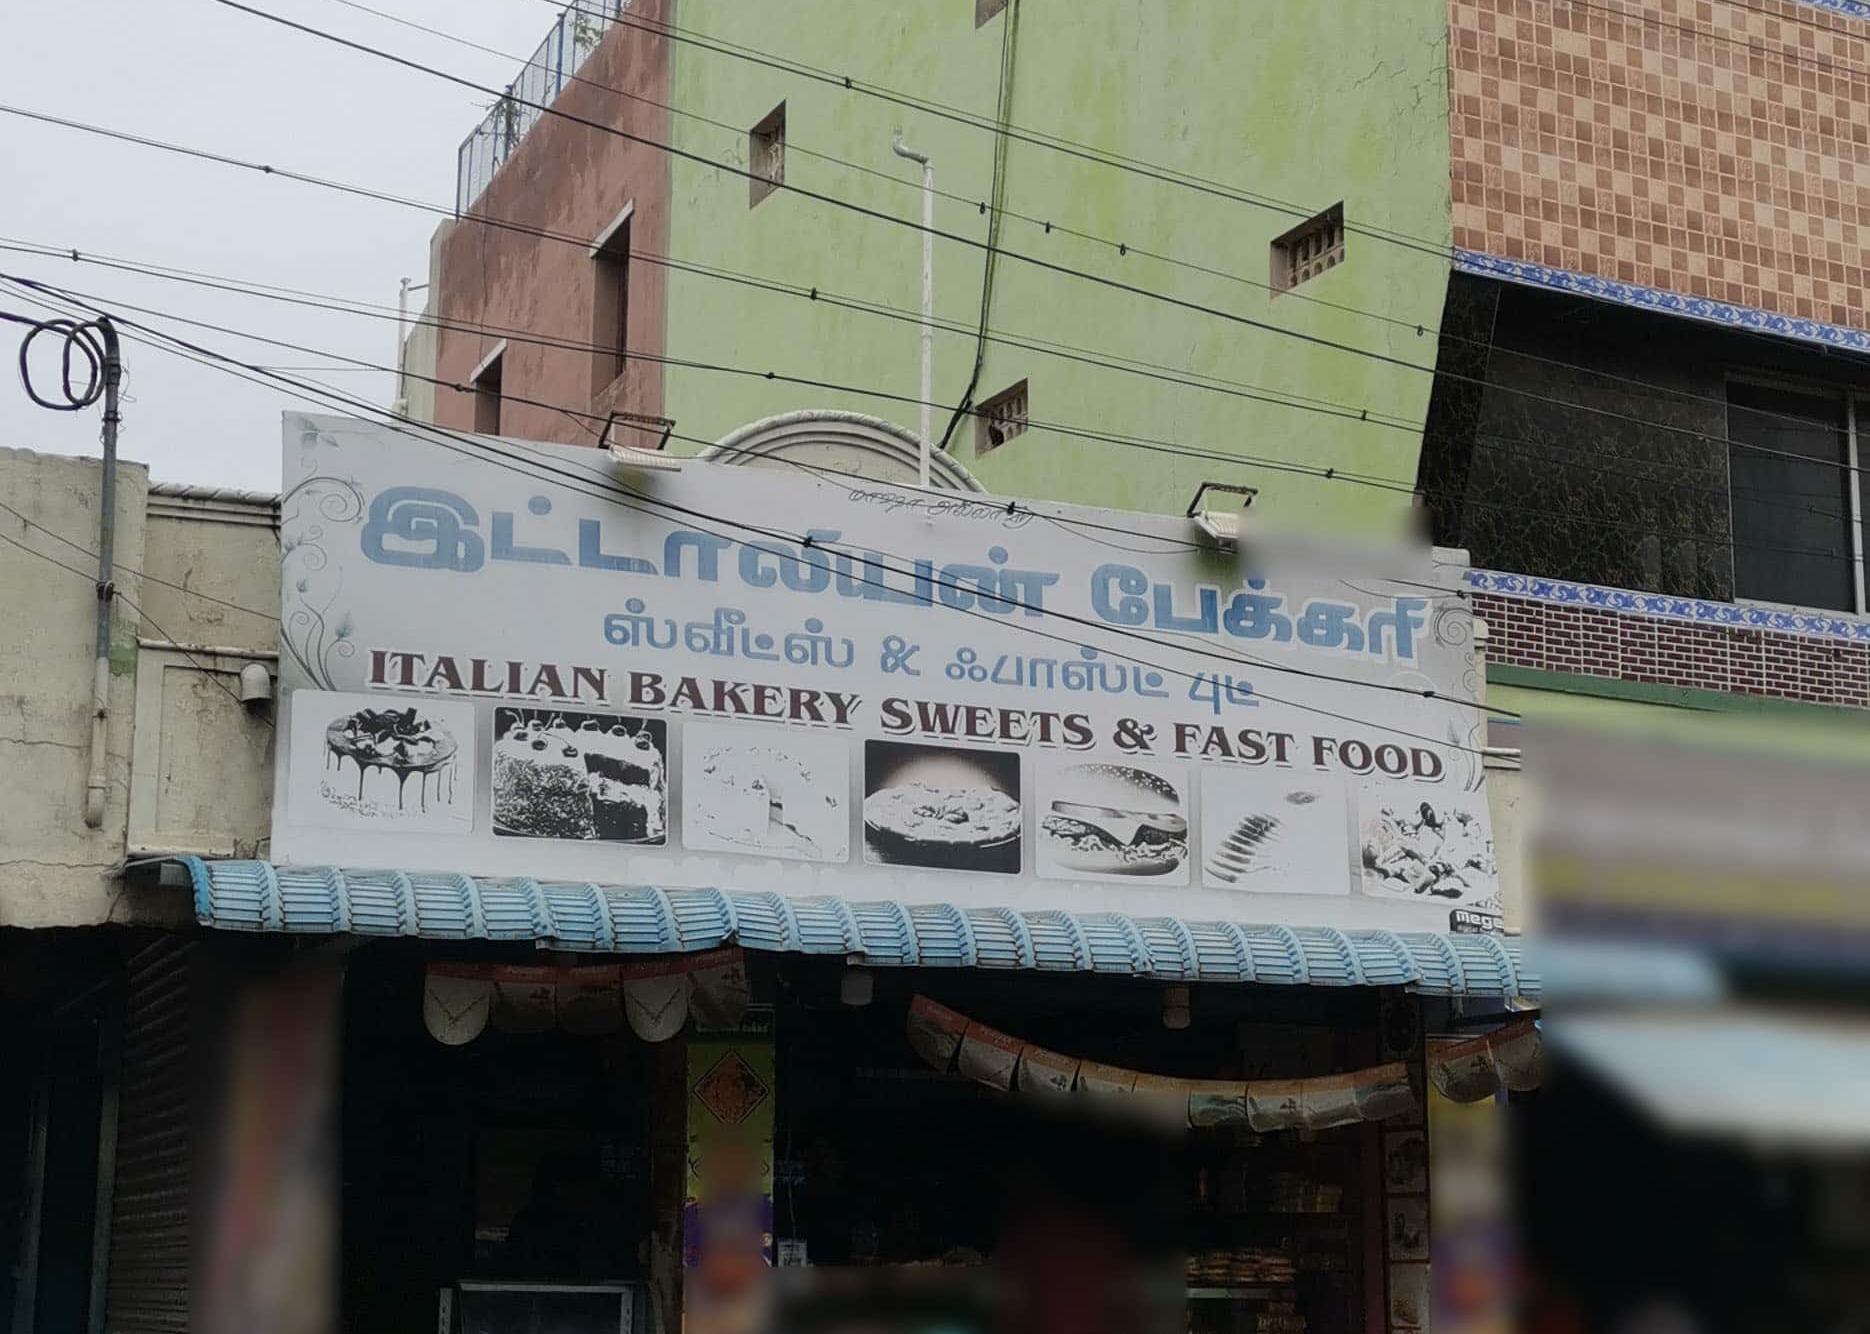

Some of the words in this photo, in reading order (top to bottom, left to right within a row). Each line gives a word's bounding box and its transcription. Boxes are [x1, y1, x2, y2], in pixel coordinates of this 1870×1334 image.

[361, 486, 1059, 617] இட்டாலியன்
[1090, 563, 1426, 659] பேக்கரி
[369, 650, 608, 701] ITALIAN
[630, 671, 861, 725] BAKERY
[880, 697, 1094, 746] SWEETS
[1113, 717, 1157, 751] &
[1174, 722, 1296, 764] FAST
[1312, 736, 1444, 780] FOOD
[604, 597, 854, 667] ஸ்வீட்ஸ்
[880, 635, 920, 676] &
[945, 645, 1169, 699] ஃபாஸ்ட்
[1188, 671, 1259, 715] புட்
